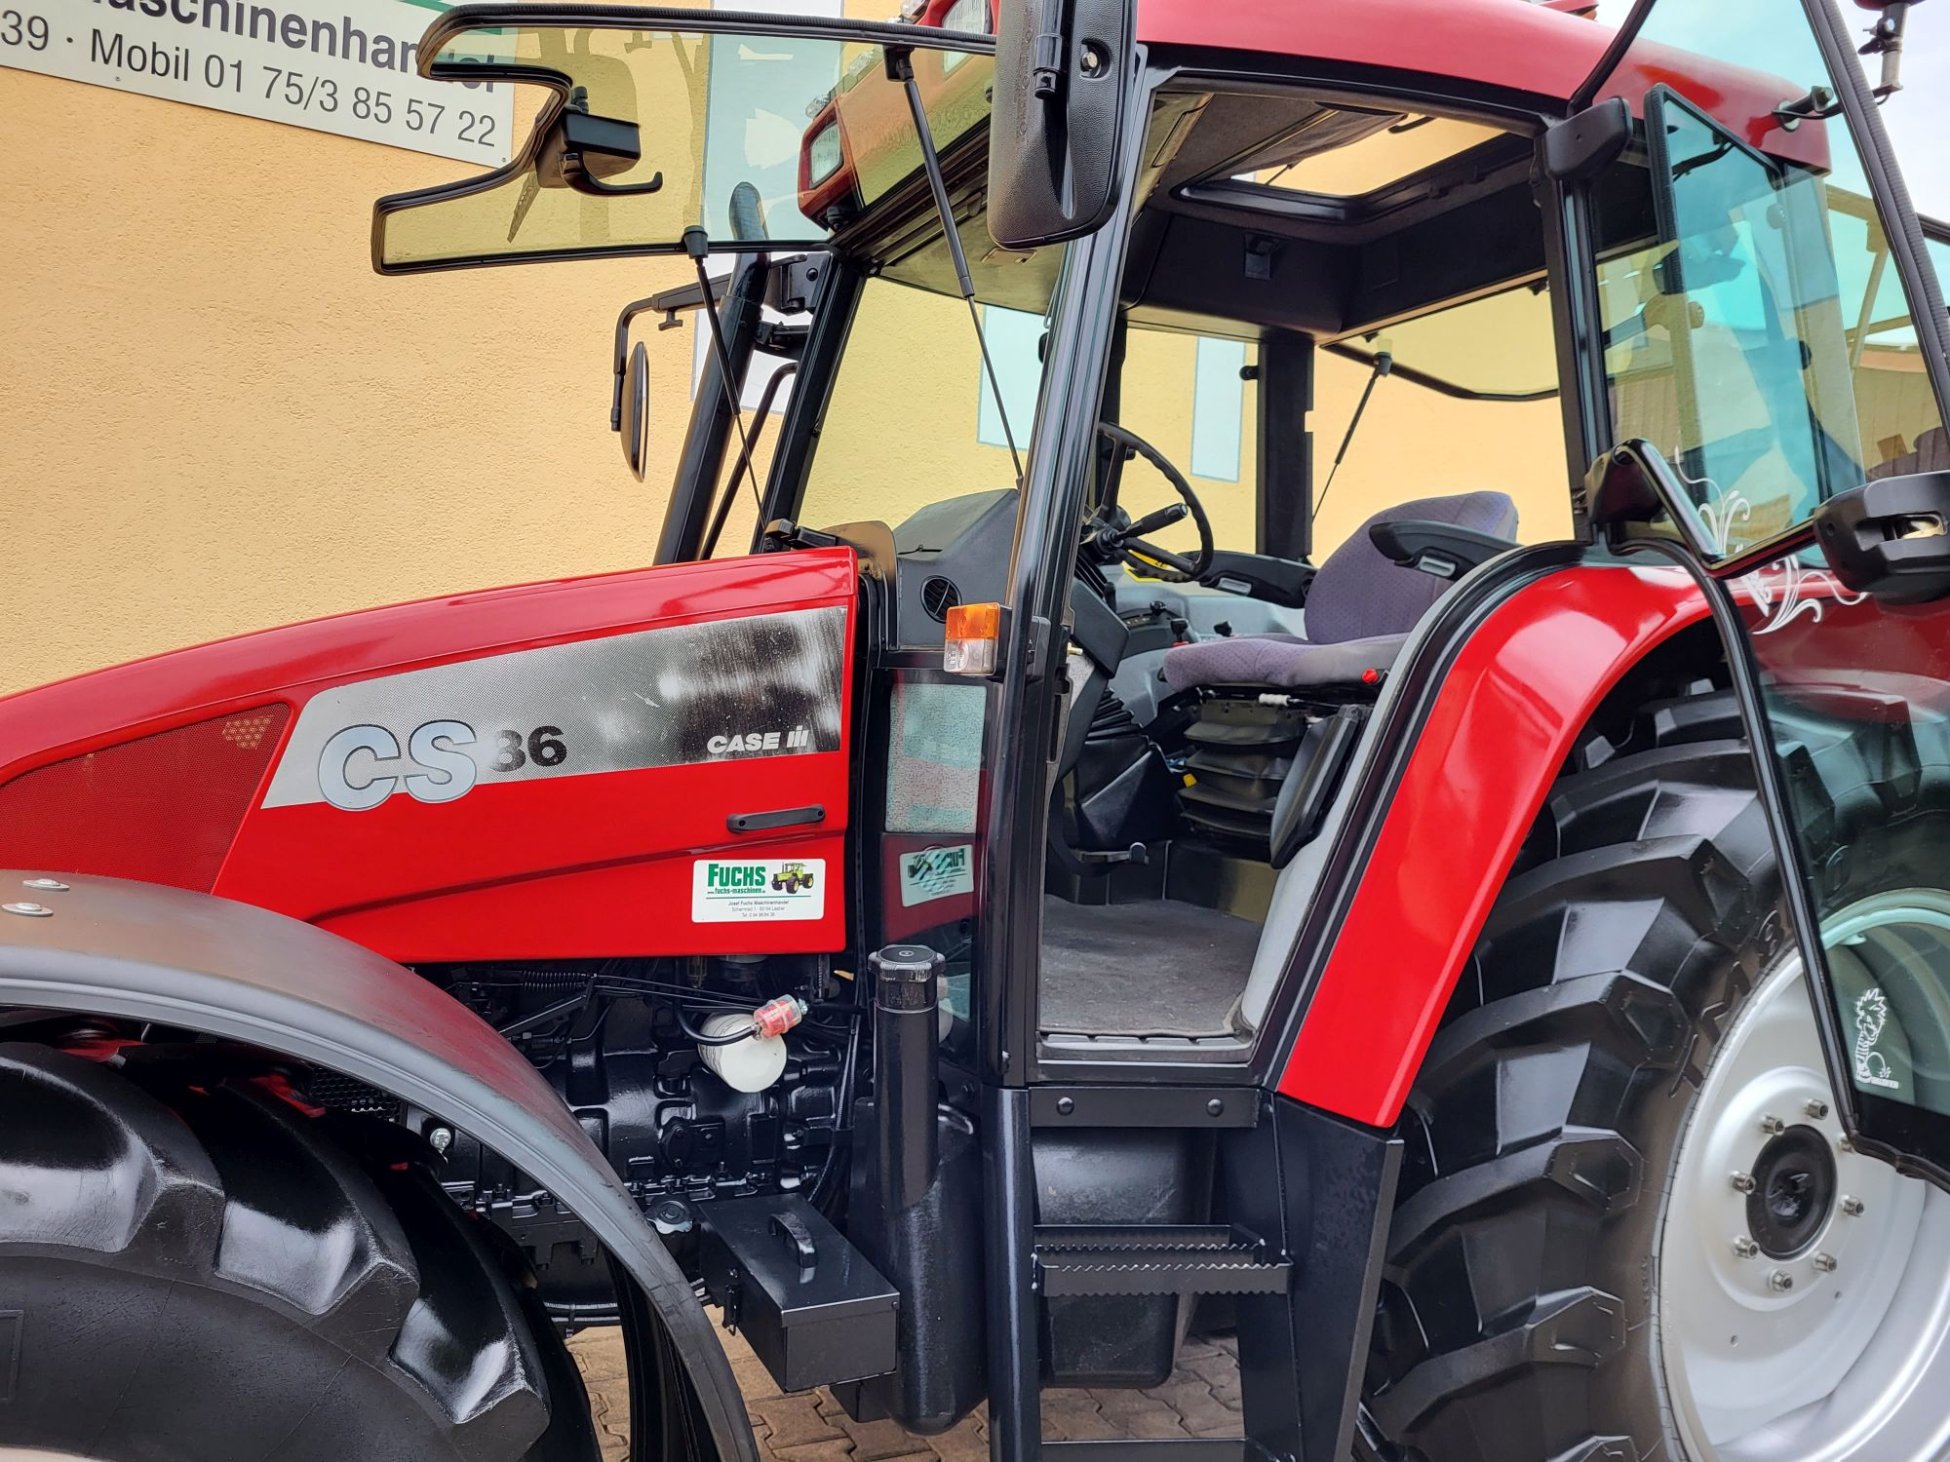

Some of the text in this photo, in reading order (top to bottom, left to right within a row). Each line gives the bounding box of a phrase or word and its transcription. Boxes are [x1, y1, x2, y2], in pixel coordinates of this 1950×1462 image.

[1, 10, 496, 147] 39 Mobil 01 75/3 85 57 22
[318, 719, 477, 812] CS
[707, 733, 781, 753] CASE
